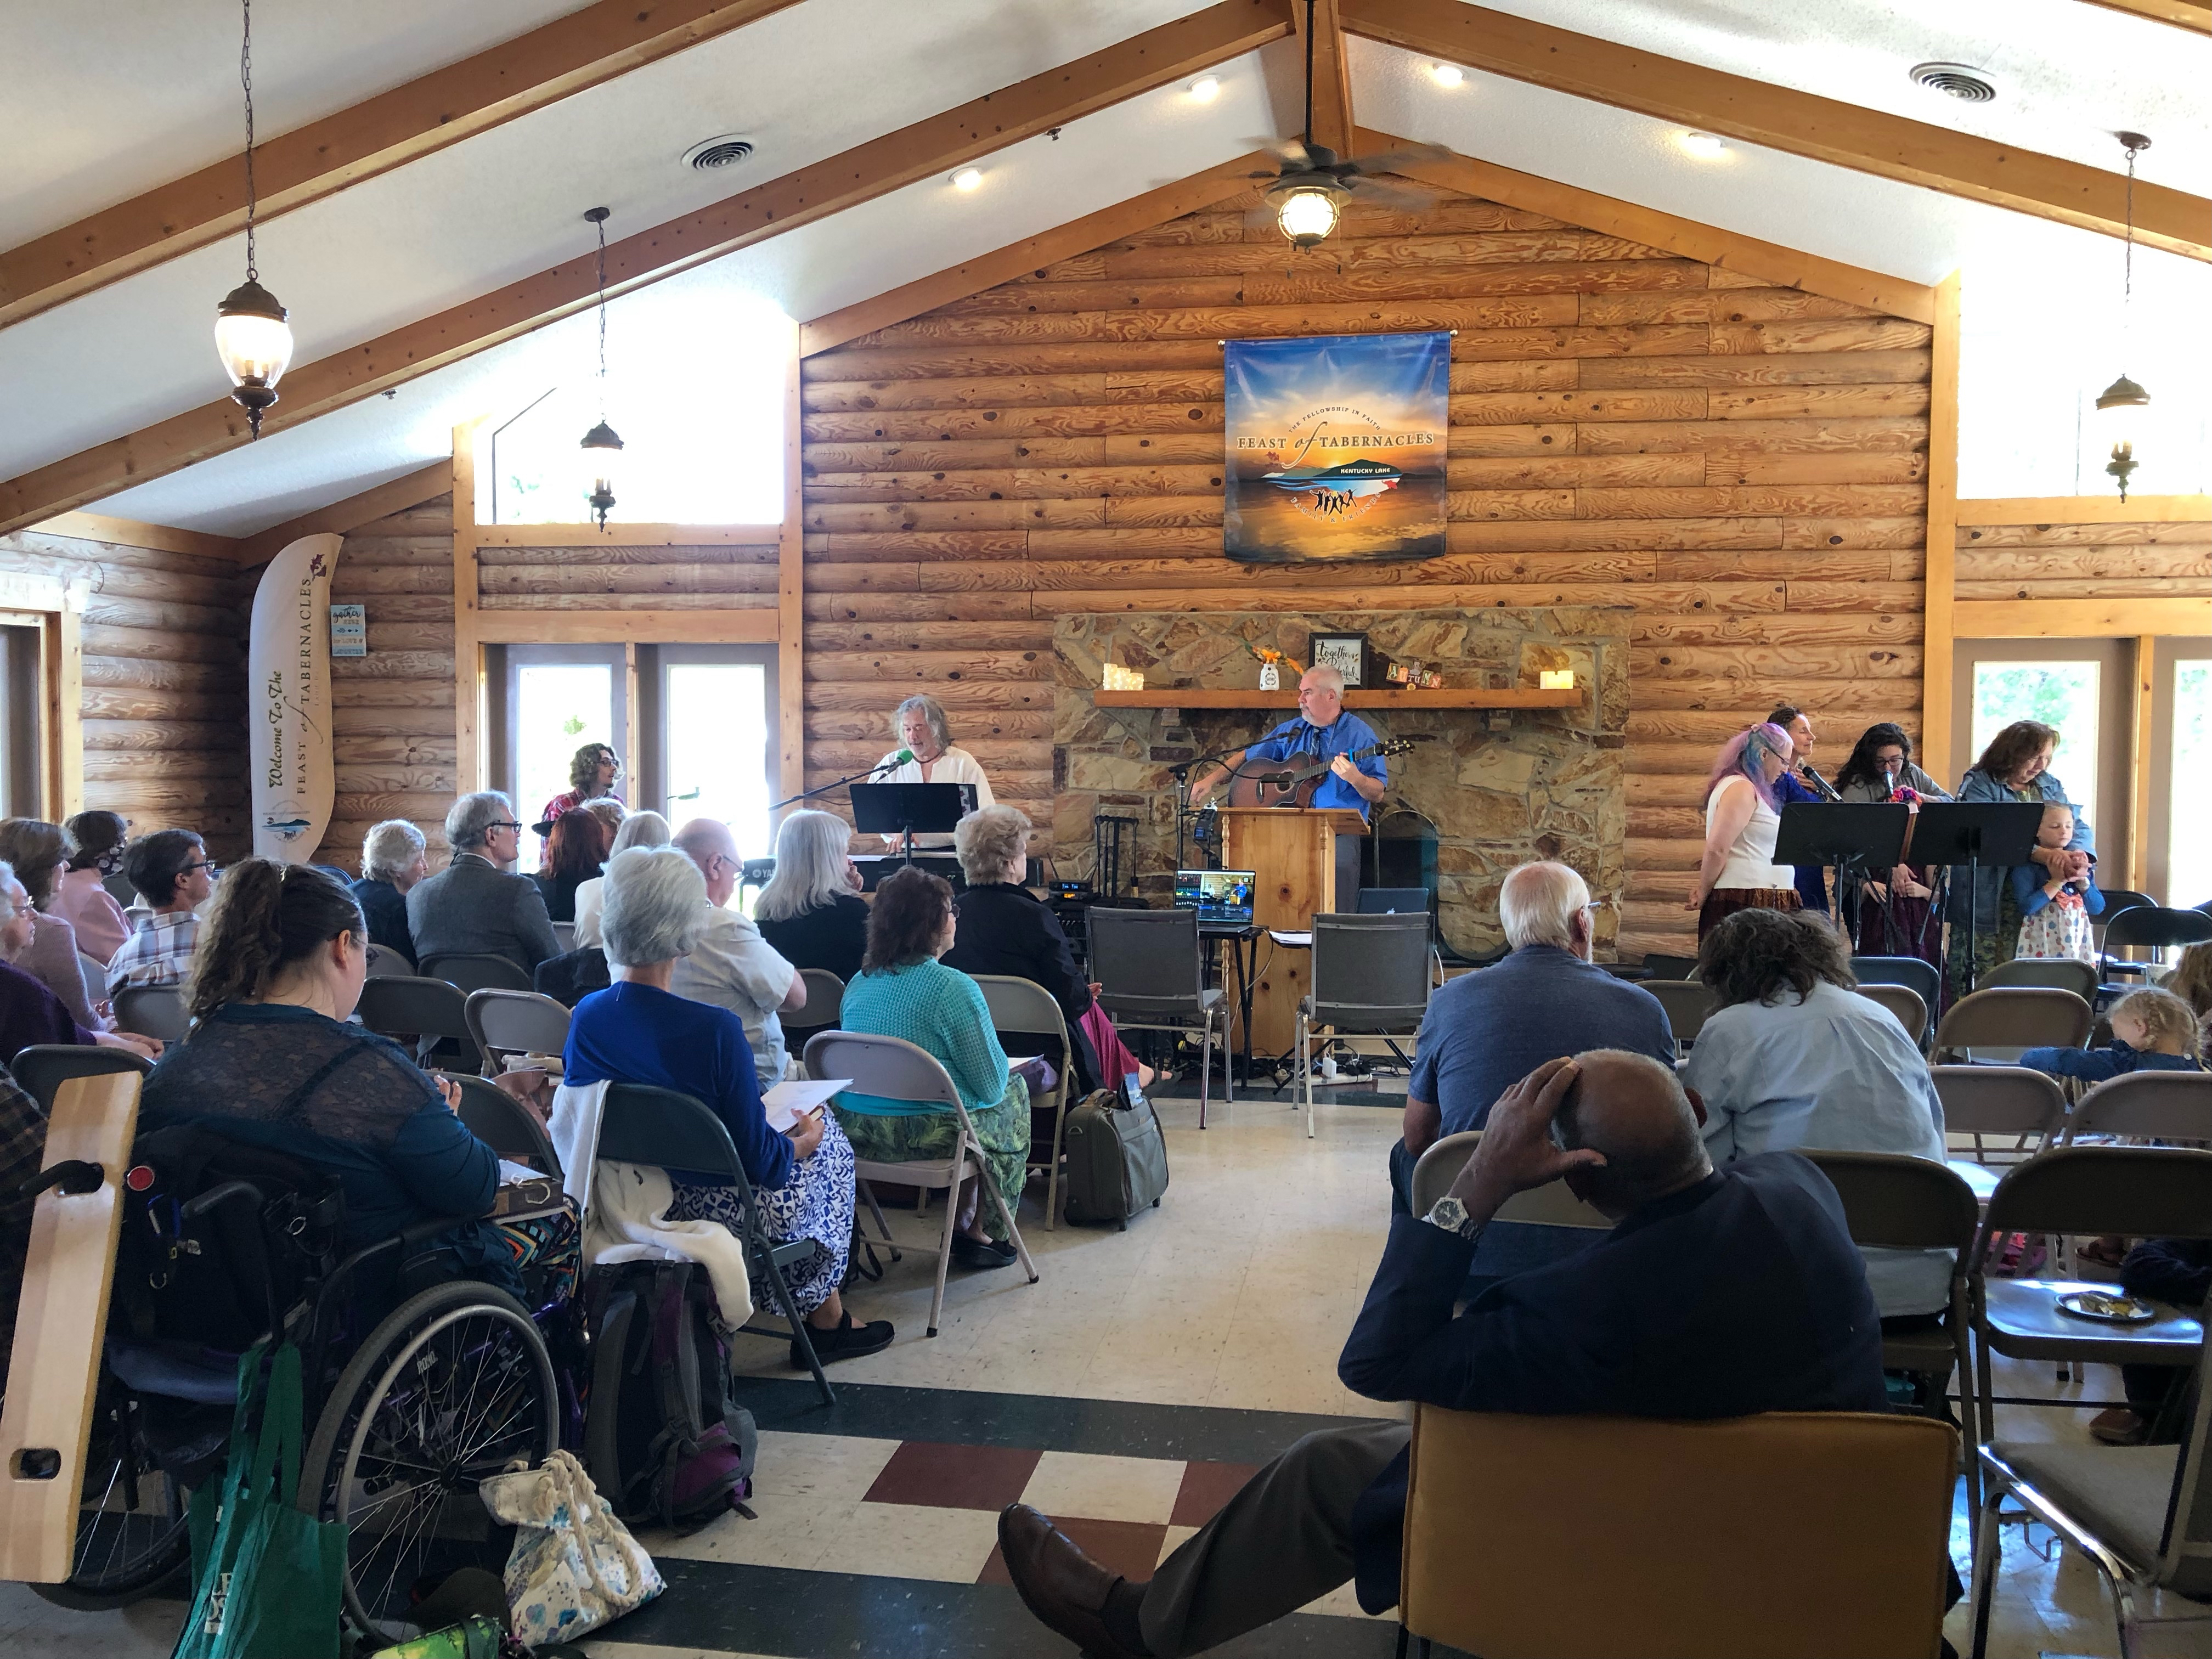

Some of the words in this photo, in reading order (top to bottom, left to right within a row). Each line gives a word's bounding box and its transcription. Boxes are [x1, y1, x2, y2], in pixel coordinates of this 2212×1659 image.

[1288, 421, 1301, 433] THE
[1302, 407, 1349, 421] FELLOWSHIP
[1362, 414, 1381, 431] FAITH
[1238, 437, 1286, 449] FEAST
[1282, 421, 1328, 470] of
[1319, 433, 1434, 448] TABERNACLES
[1290, 496, 1323, 521] FAMILY
[1342, 492, 1381, 522] FRIENDS
[332, 608, 361, 624] gather
[300, 578, 312, 704] TABERNACLES
[268, 670, 283, 699] The
[1387, 665, 1441, 687] AUTUMN
[268, 702, 283, 724] To
[283, 696, 324, 744] of
[268, 727, 283, 788] Welcome
[297, 742, 306, 794] FEAST
